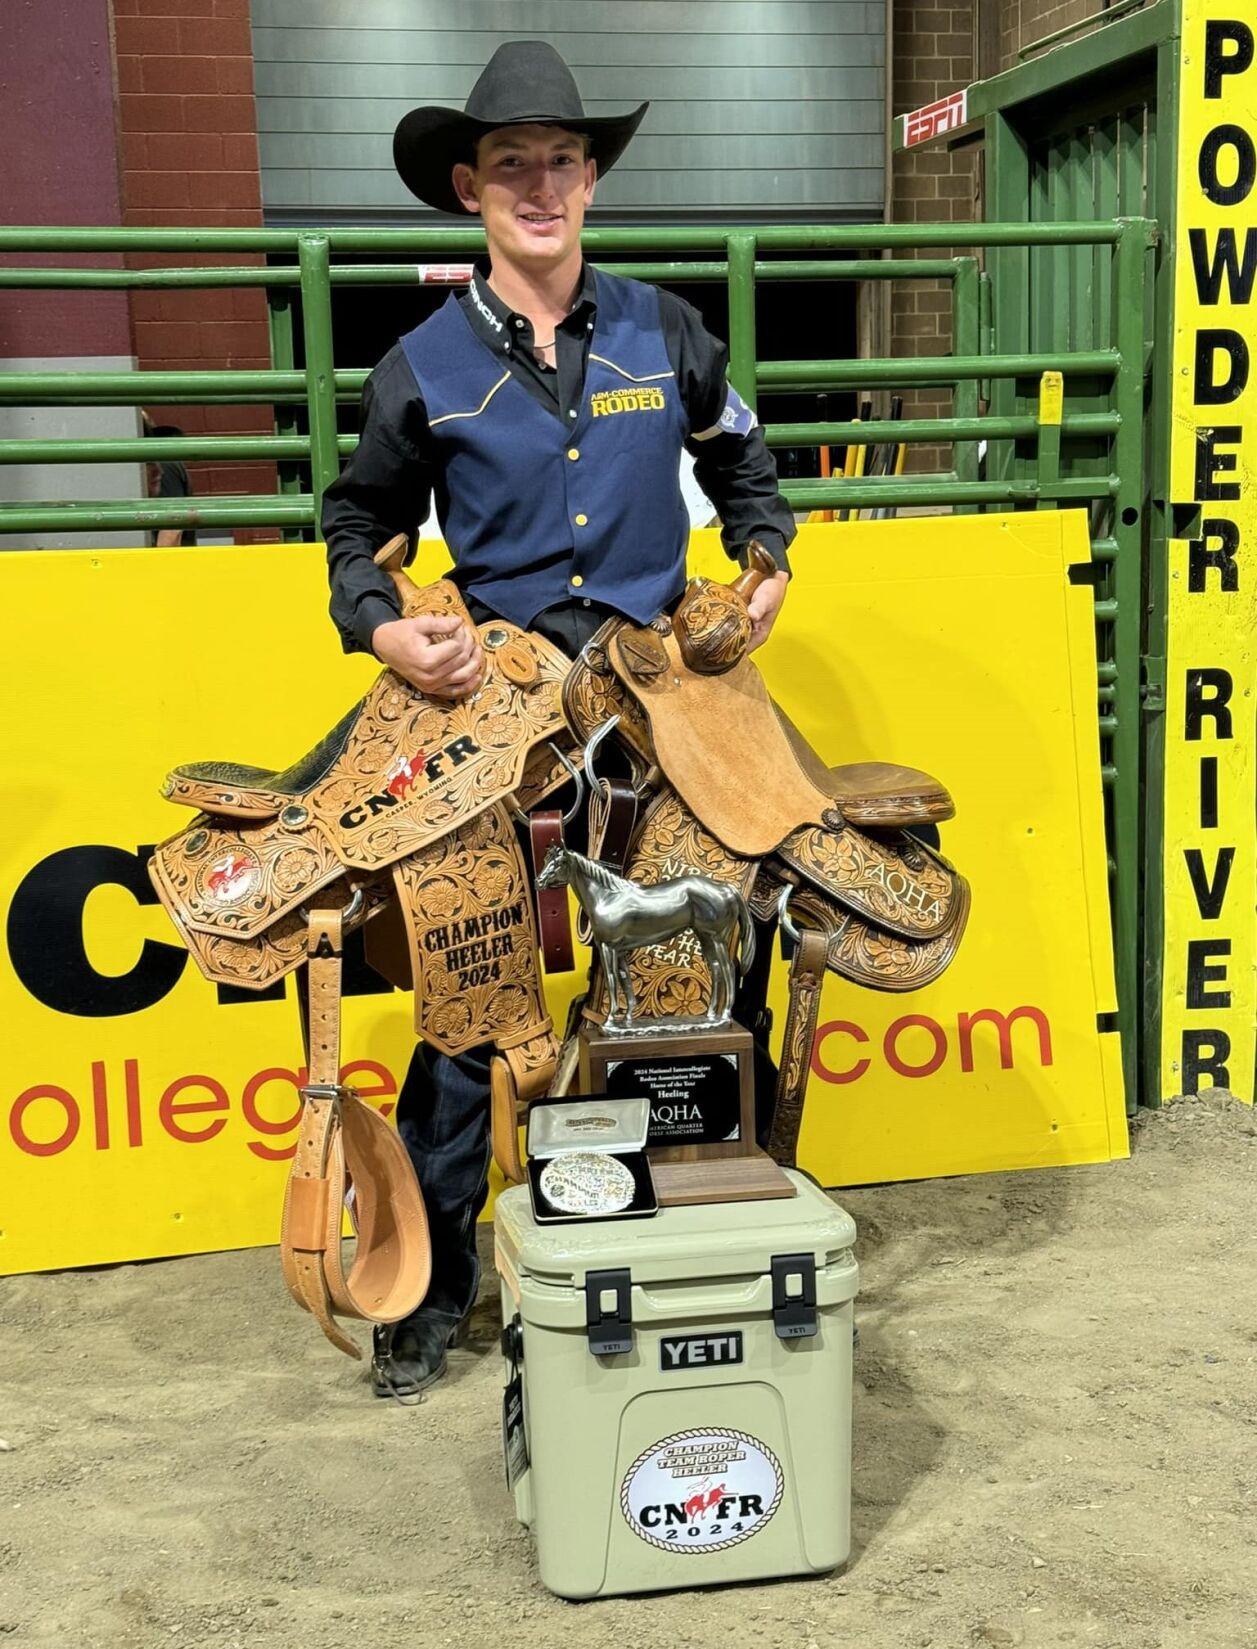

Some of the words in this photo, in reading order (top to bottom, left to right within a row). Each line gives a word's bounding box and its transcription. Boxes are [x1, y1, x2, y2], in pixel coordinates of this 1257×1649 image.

[906, 92, 963, 147] ESPN
[470, 279, 503, 332] CINCH
[1188, 20, 1257, 593] POWDER
[591, 394, 665, 417] RODEO
[339, 735, 482, 830] CNFR
[416, 777, 452, 800] WYOMING
[868, 862, 944, 923] AQHA
[1182, 668, 1235, 1096] RIVER
[424, 904, 523, 953] CHAMPION
[444, 935, 514, 973] HEELER
[645, 944, 691, 968] YEAR
[457, 965, 501, 992] 2024
[658, 1090, 689, 1099] Heeling
[664, 1338, 737, 1365] YETI
[657, 1456, 697, 1469] TEAM
[697, 1451, 746, 1465] ROPER
[664, 1441, 739, 1457] CHAMPION
[672, 1463, 728, 1478] HEELER
[639, 1494, 763, 1528] CNFR
[665, 1521, 744, 1540] 2024
